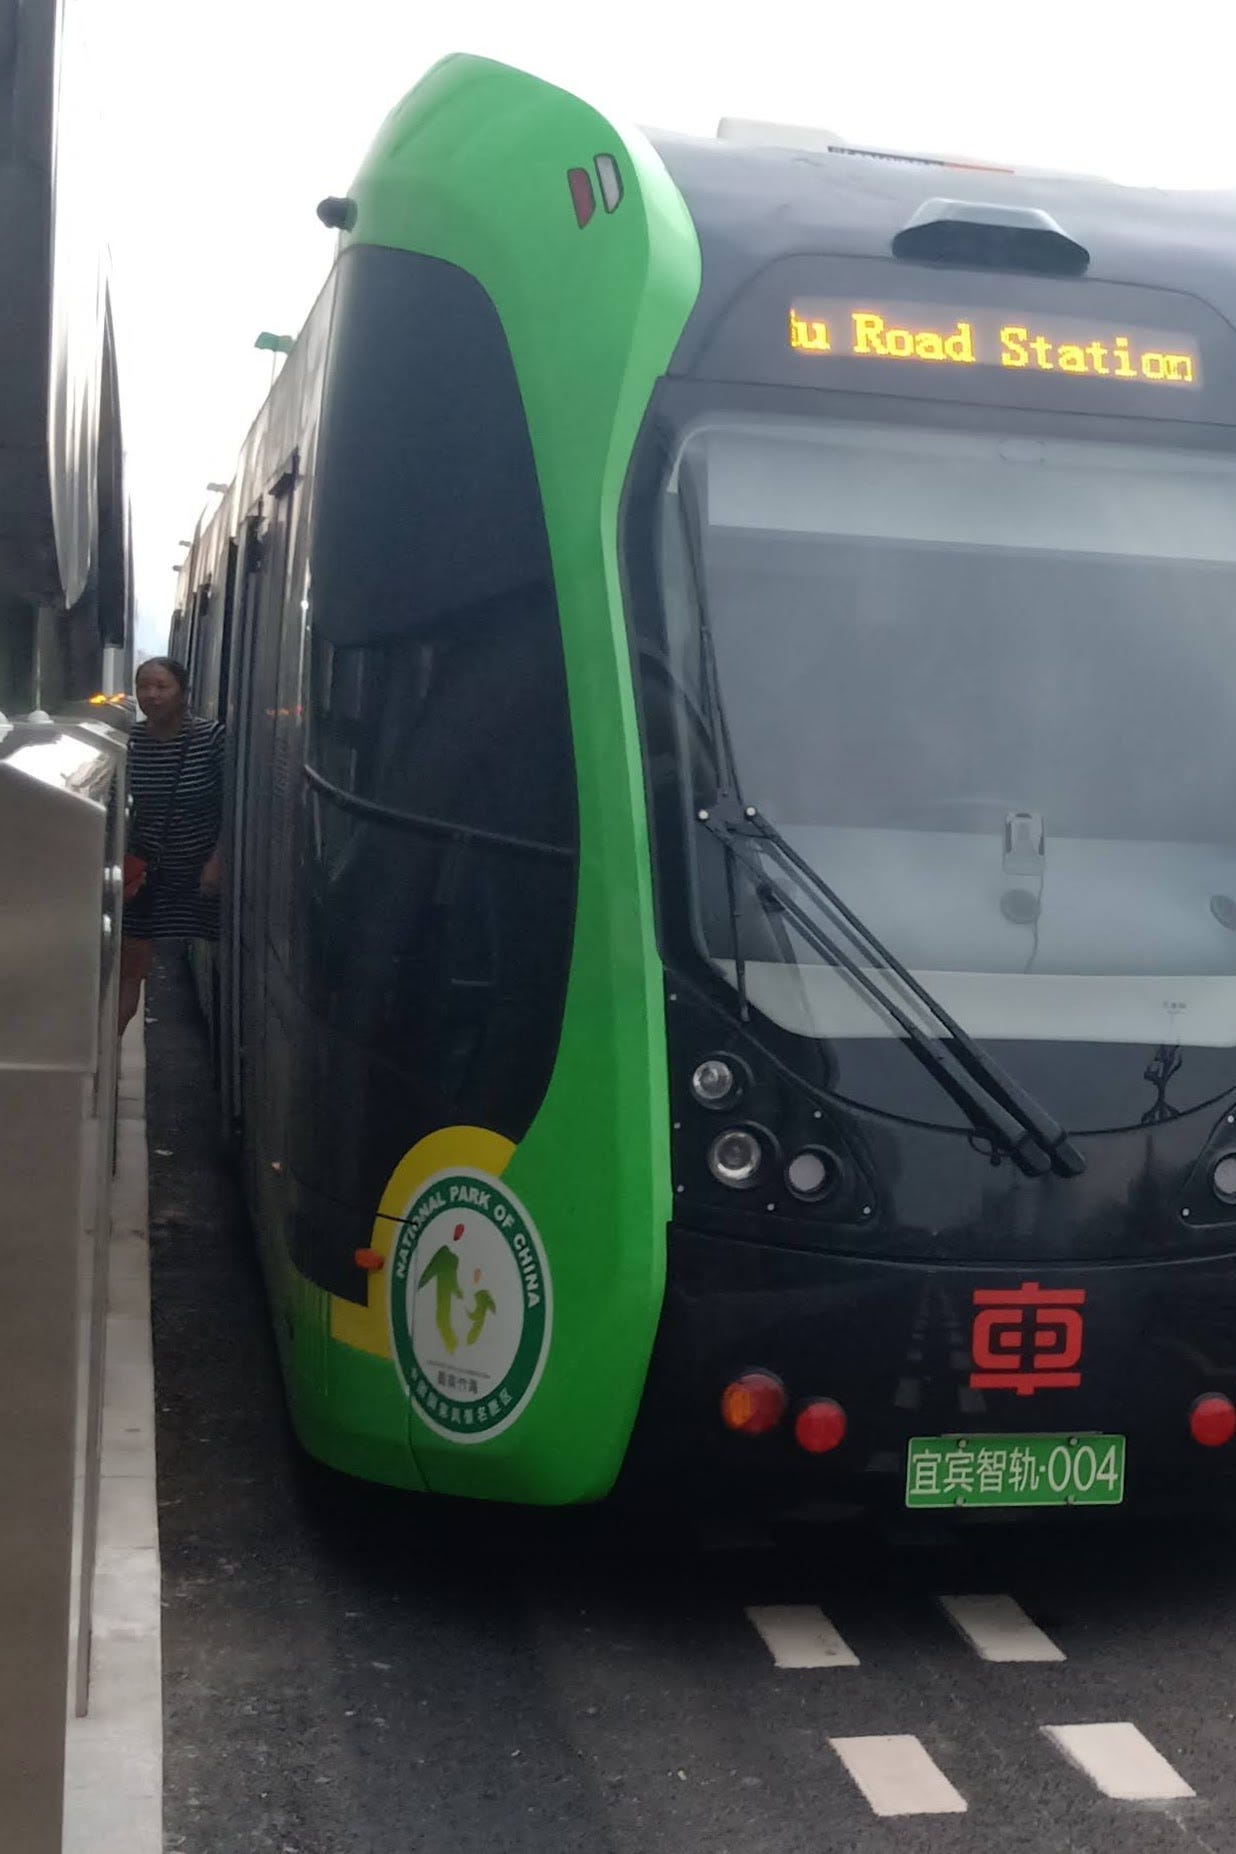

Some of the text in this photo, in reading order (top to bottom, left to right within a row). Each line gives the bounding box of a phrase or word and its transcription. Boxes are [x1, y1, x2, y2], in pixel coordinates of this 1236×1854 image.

[851, 312, 976, 363] Road
[1000, 325, 1193, 382] Station
[396, 1185, 541, 1309] NATIONAL PARK OF CHINA
